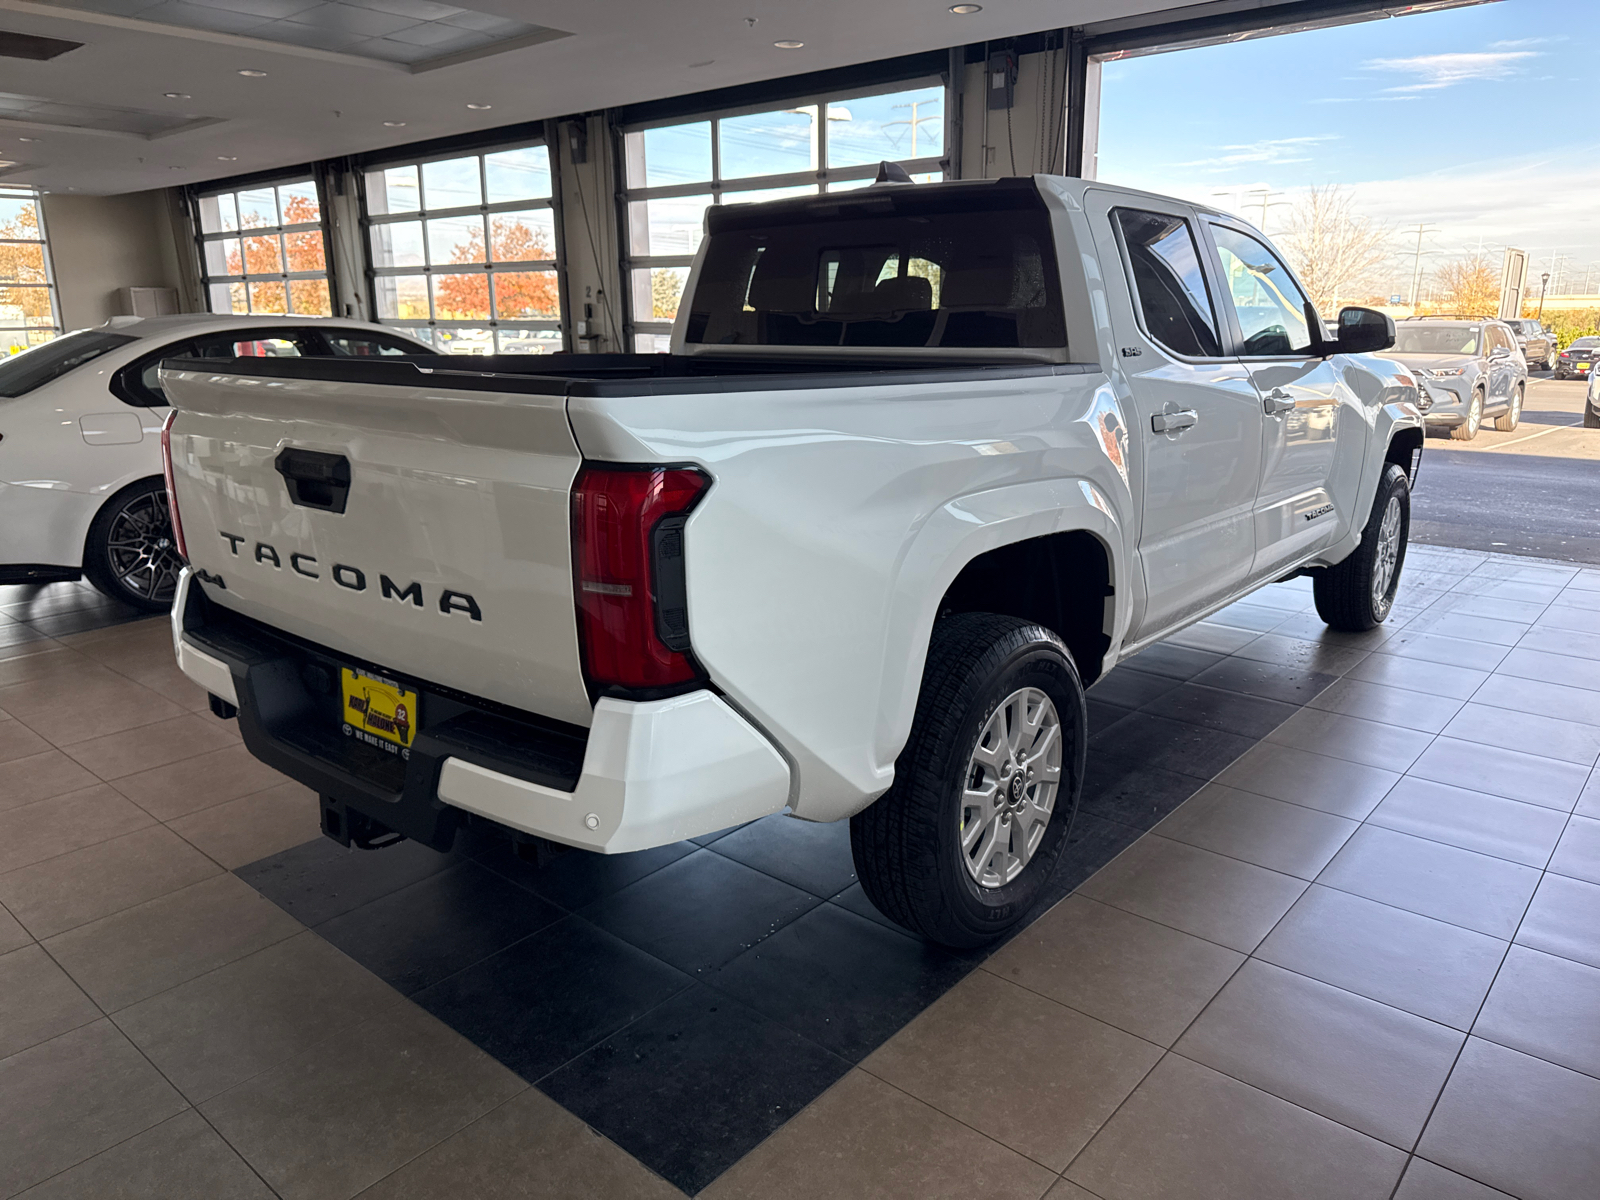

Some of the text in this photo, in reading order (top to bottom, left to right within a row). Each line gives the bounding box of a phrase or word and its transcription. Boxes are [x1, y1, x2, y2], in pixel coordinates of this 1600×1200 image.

[585, 286, 592, 298] 2
[1304, 503, 1335, 521] TACOMA
[219, 530, 483, 623] TACOMA
[396, 708, 406, 721] 32
[354, 729, 399, 755] WE MAKE IT EASY
